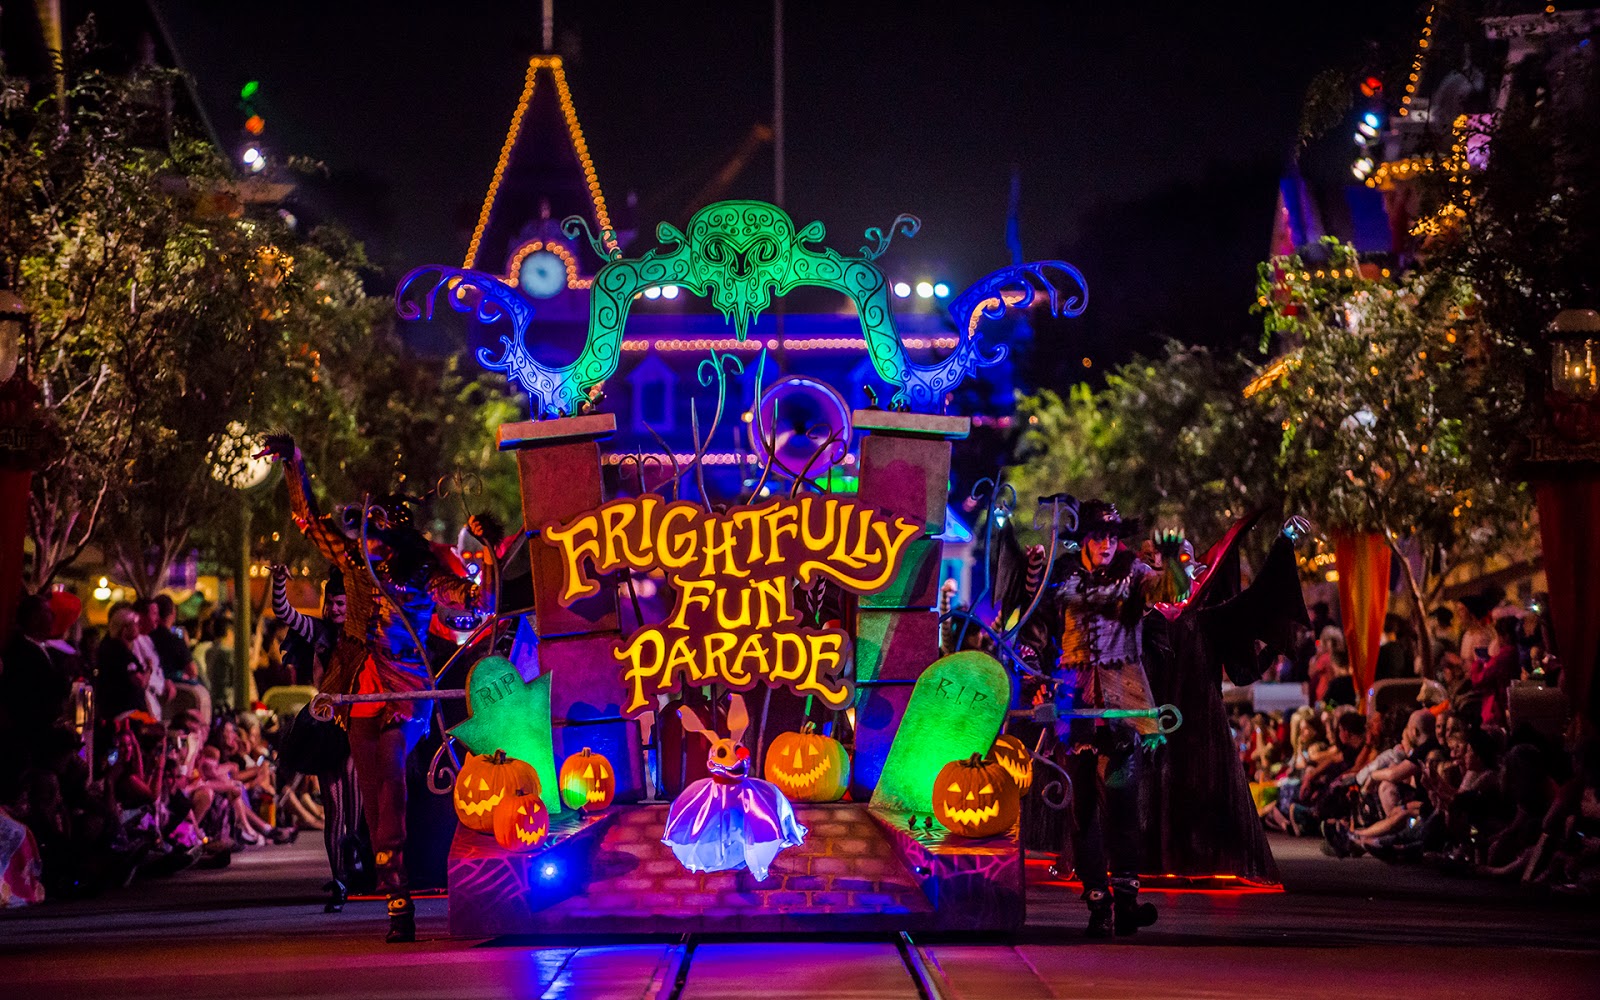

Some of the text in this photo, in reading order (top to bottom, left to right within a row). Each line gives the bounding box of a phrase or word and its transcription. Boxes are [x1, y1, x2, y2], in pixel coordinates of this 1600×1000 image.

[546, 497, 920, 600] FRIGHTFULLY
[668, 575, 796, 631] FUN
[614, 629, 849, 713] PARADE
